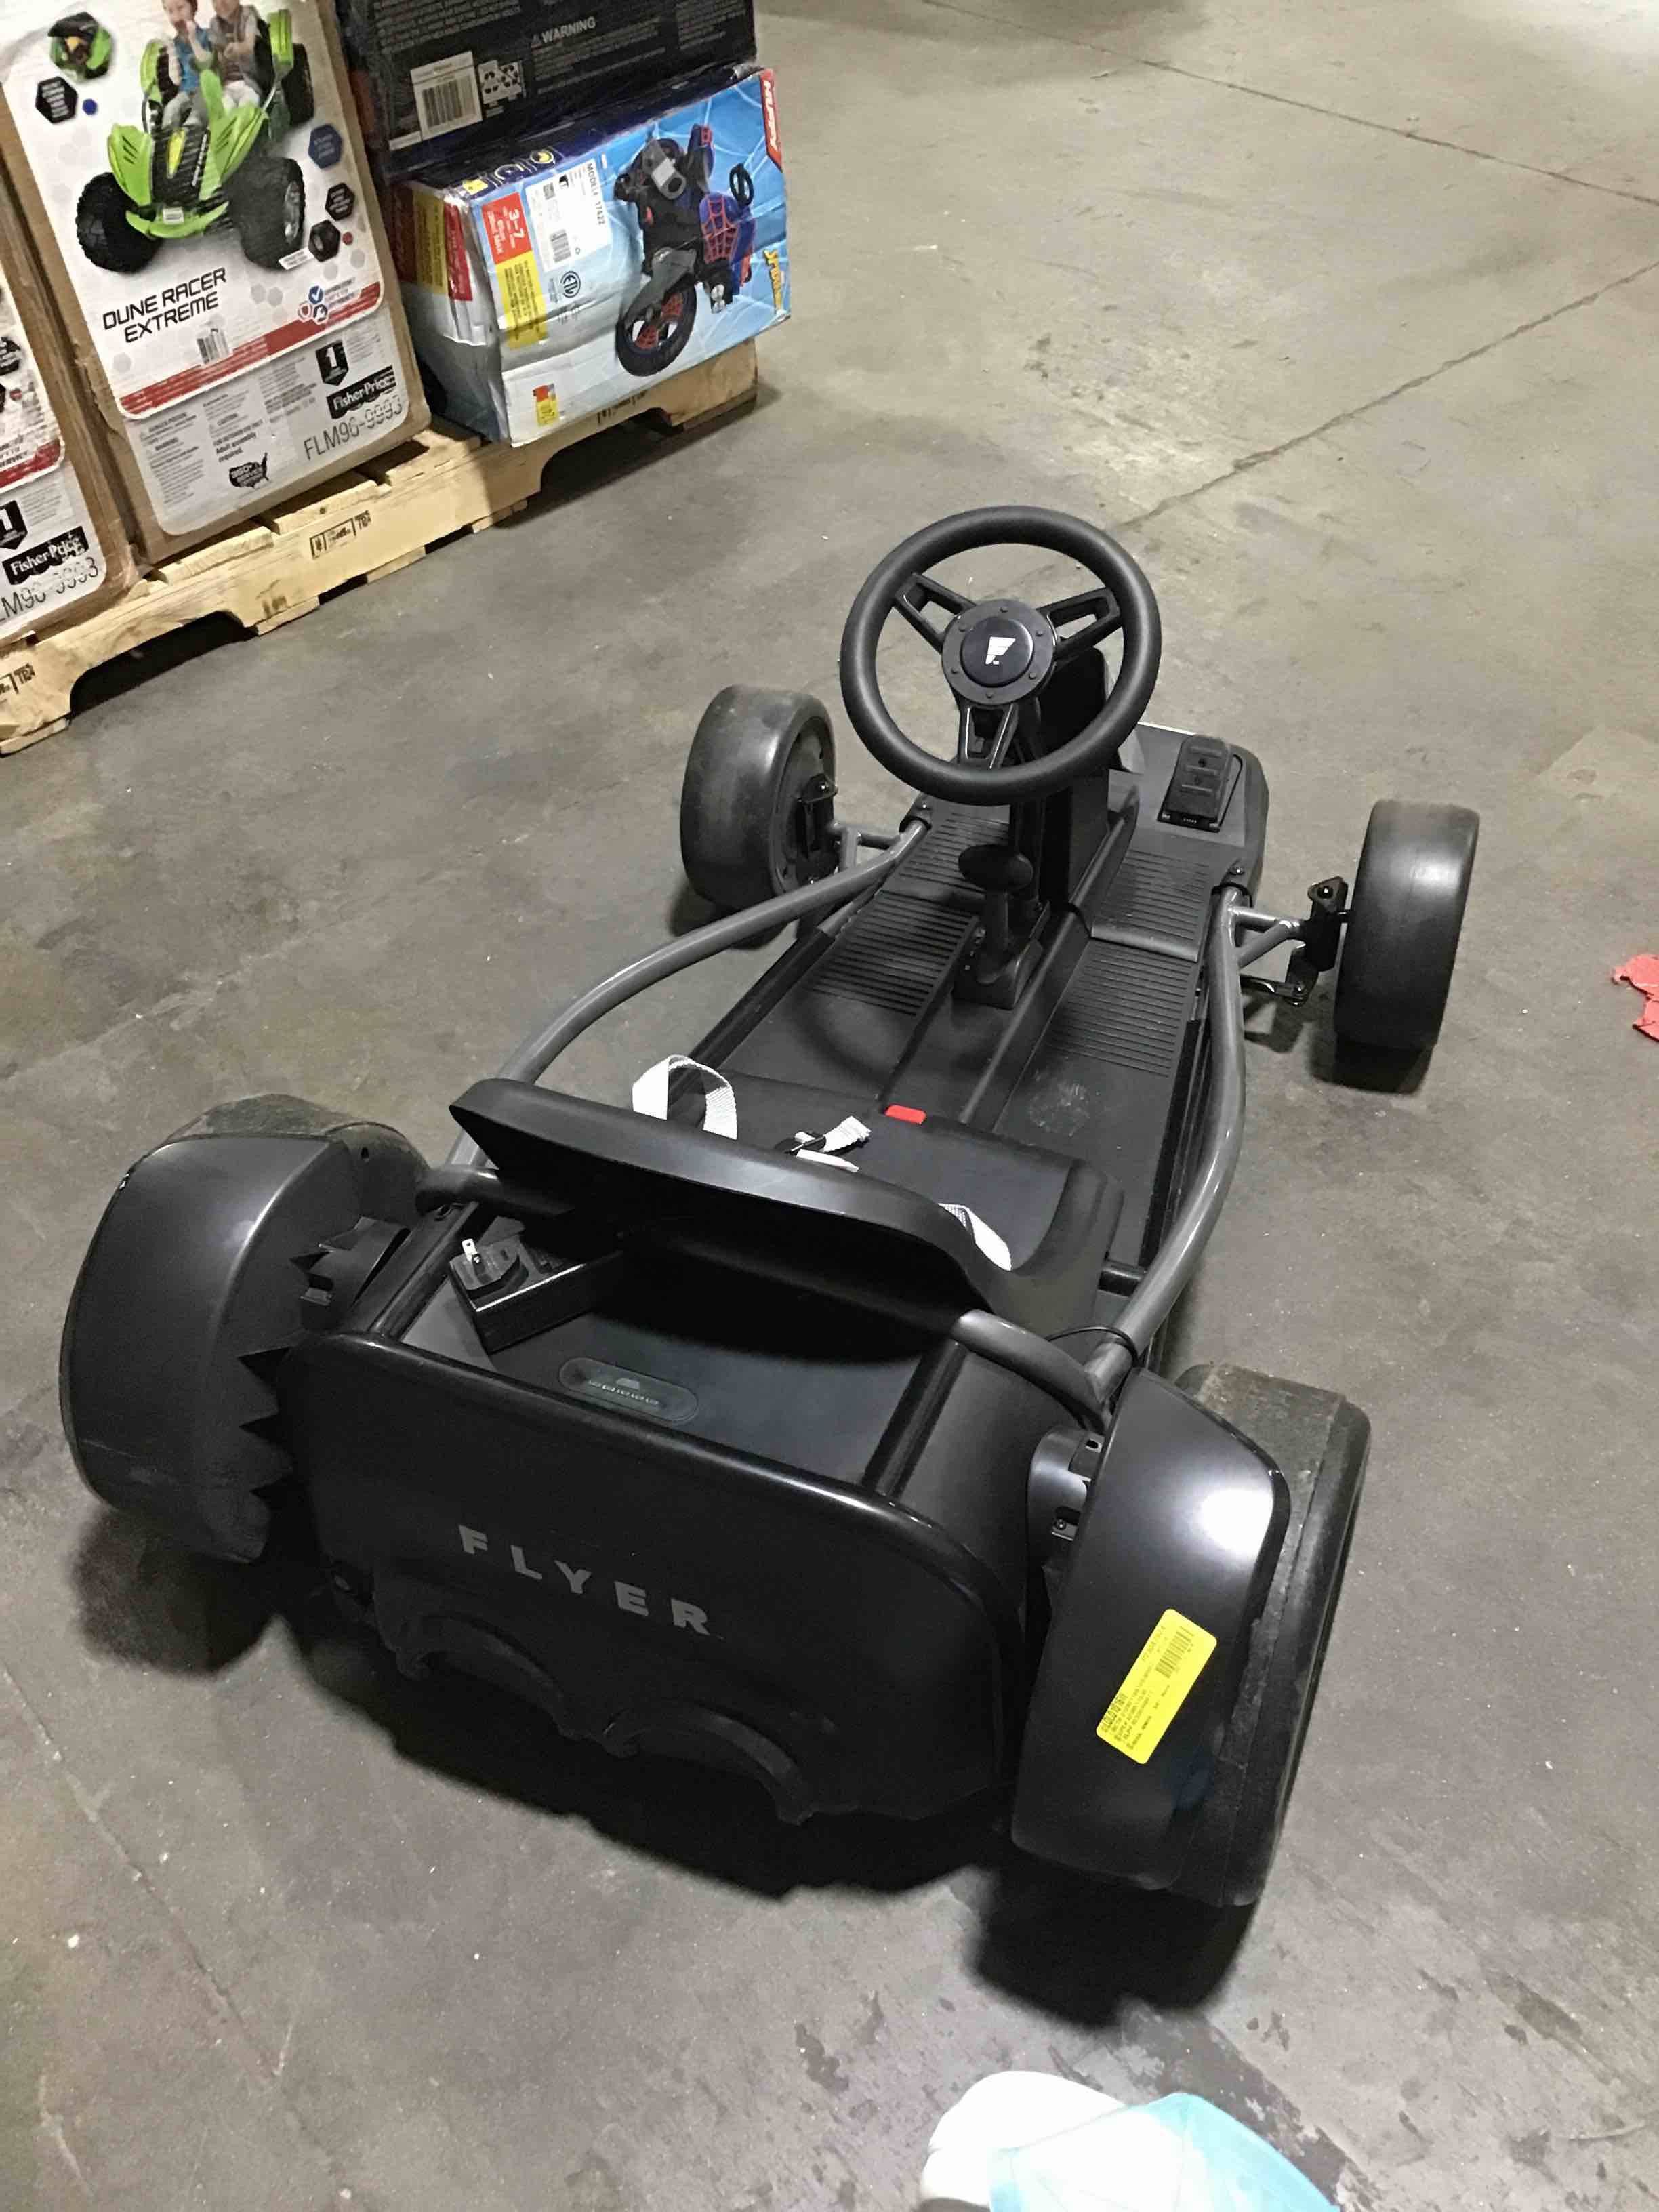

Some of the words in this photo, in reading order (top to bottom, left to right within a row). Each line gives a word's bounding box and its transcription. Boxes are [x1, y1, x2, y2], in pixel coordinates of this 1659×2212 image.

[541, 16, 596, 44] WARNING
[103, 295, 158, 330] DUNE
[161, 267, 226, 307] RACER
[124, 291, 218, 343] EXTREME
[325, 346, 337, 368] 1
[458, 1524, 710, 1635] FLYER
